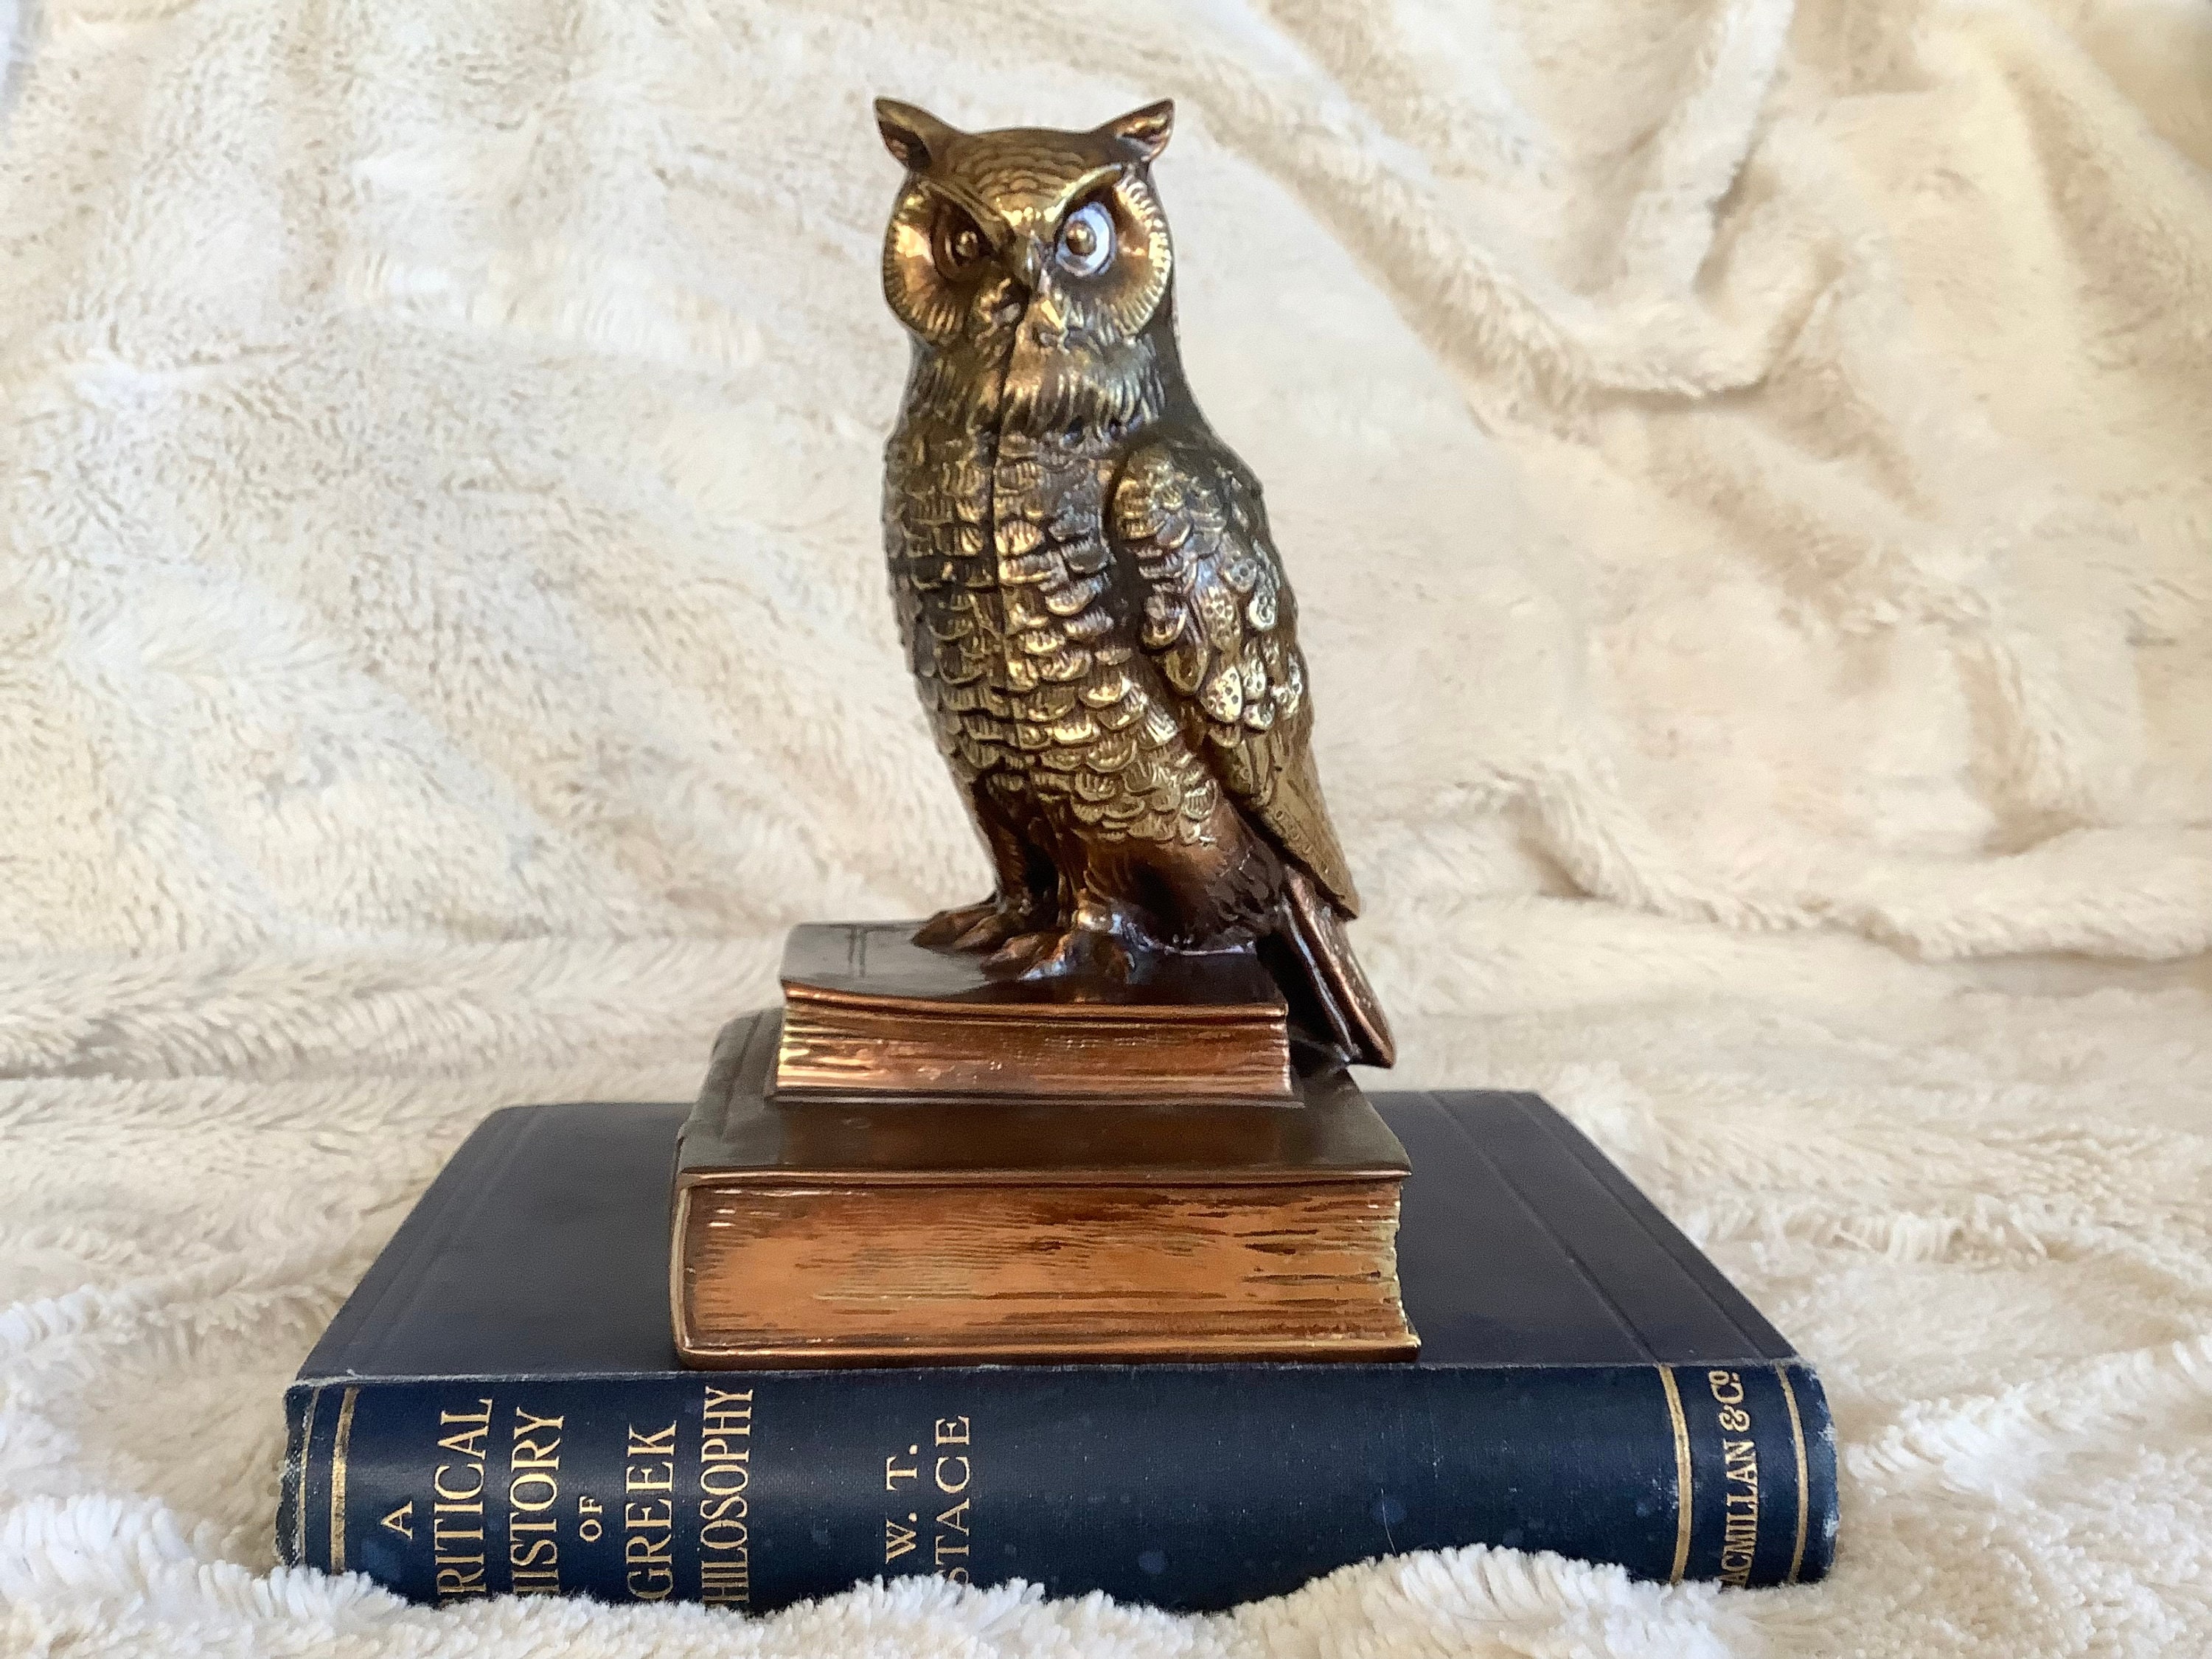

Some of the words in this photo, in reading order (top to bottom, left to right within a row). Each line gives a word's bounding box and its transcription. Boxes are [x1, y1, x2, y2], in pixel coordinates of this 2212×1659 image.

[434, 1399, 493, 1596] RITICAL
[626, 1420, 677, 1599] GREEK
[700, 1385, 753, 1602] HILOSOPHY
[886, 1444, 919, 1491] T.
[1718, 1438, 1758, 1589] ACMILLAN
[380, 1501, 413, 1540] A
[580, 1496, 603, 1542] OF
[886, 1512, 918, 1565] W.
